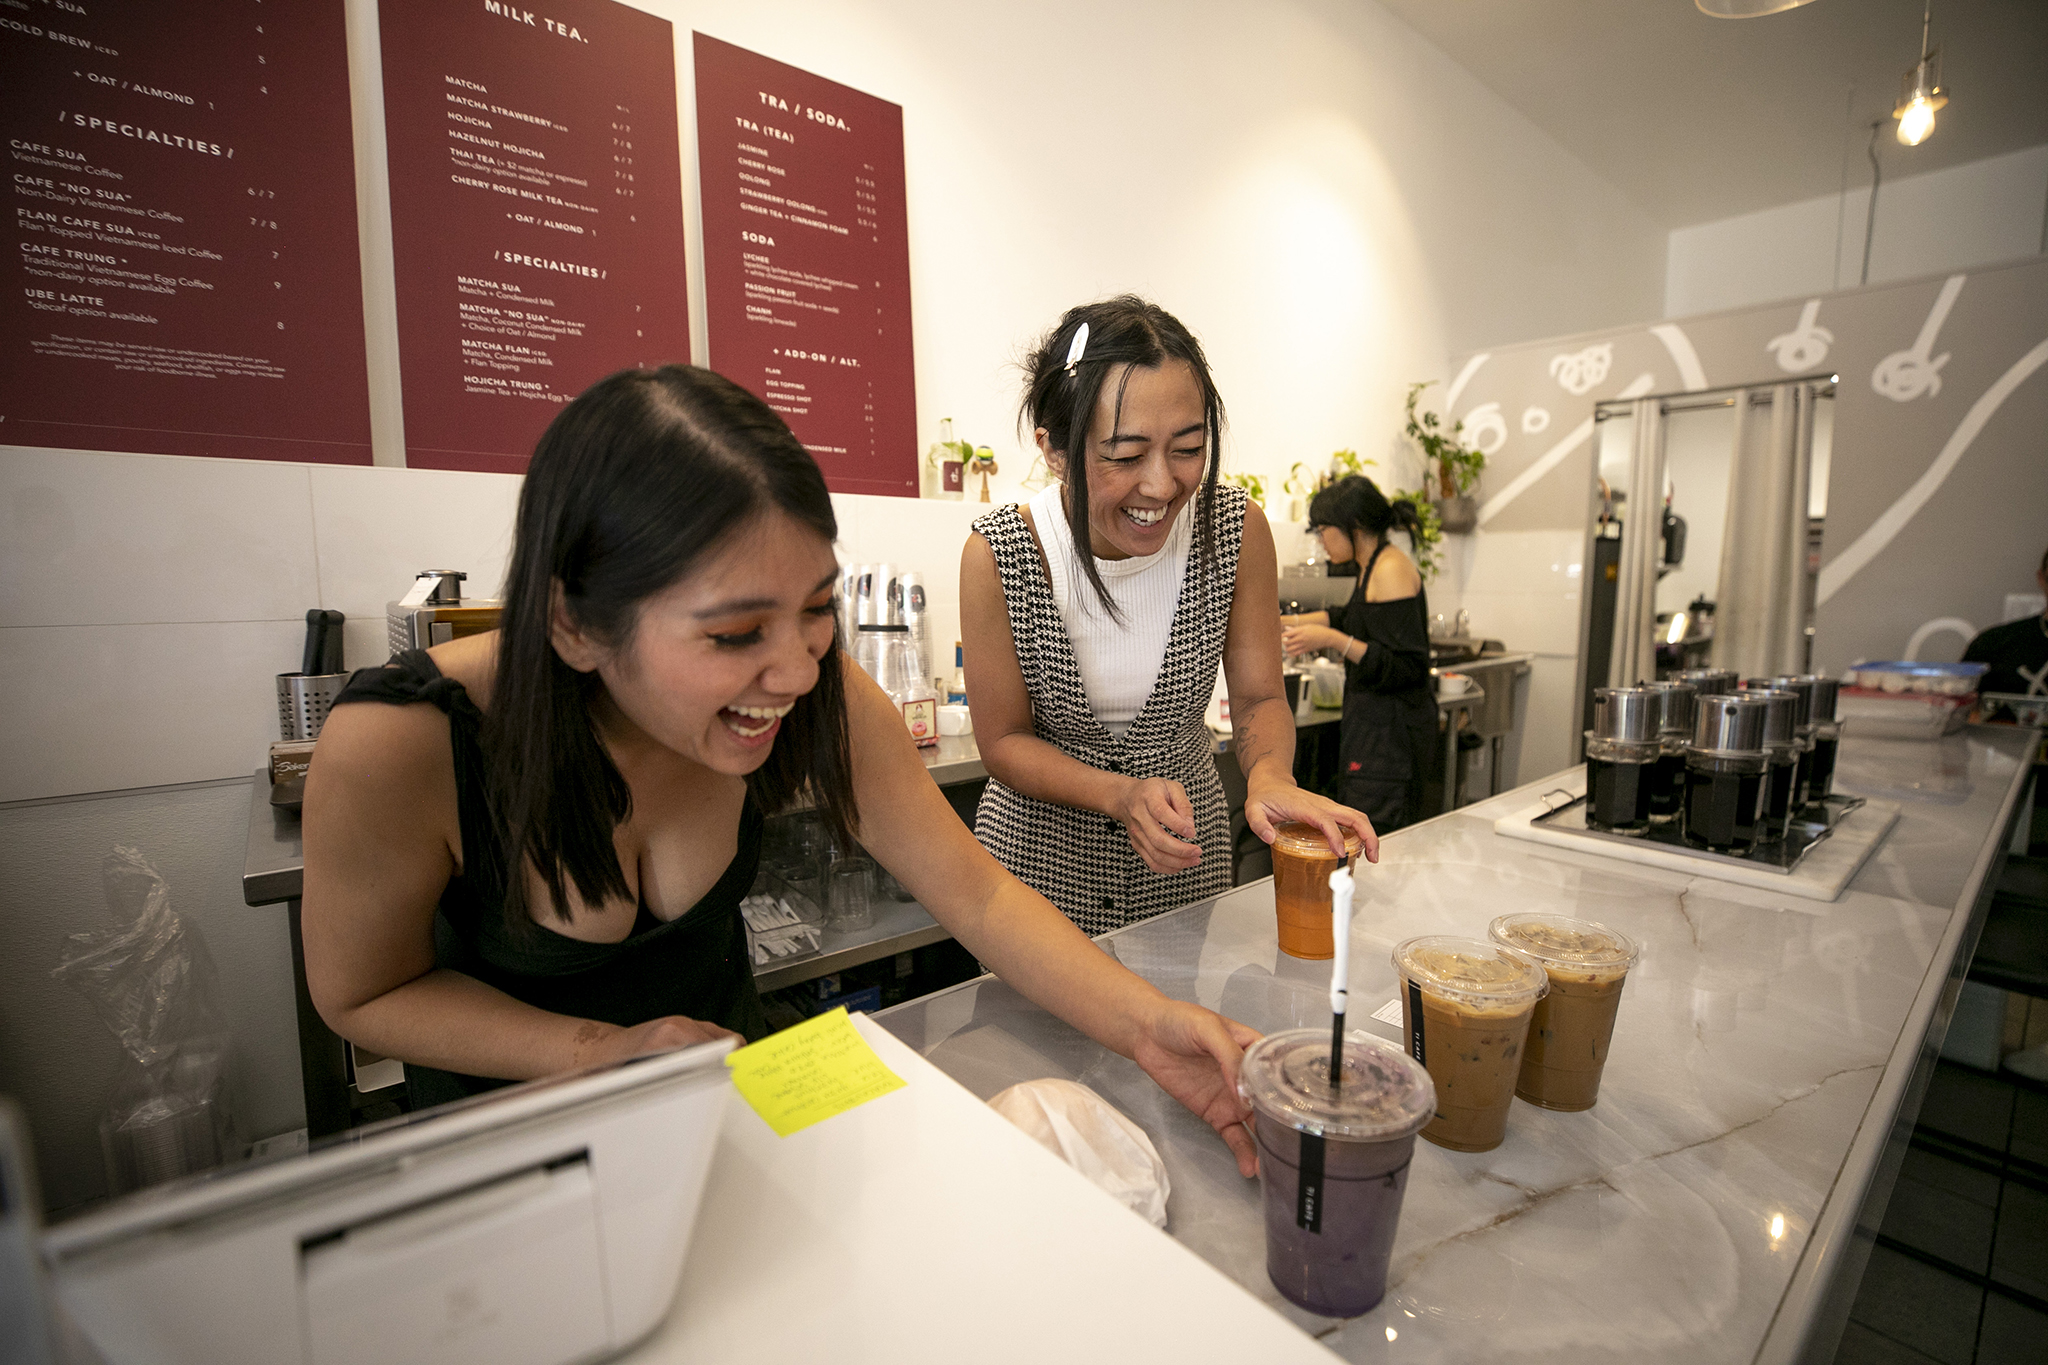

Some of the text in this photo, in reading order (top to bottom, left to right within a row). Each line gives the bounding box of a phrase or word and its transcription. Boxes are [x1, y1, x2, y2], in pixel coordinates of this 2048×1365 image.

[55, 0, 86, 15] SUA
[485, 0, 535, 26] MILK
[0, 18, 42, 36] COLD
[48, 30, 91, 48] BREW
[87, 73, 116, 86] OAT
[133, 84, 194, 104] ALMOND
[445, 75, 487, 93] MATCHA
[446, 93, 488, 111] MATCHA
[490, 105, 551, 127] STRAWBERRY
[447, 111, 492, 129] HOJICHA
[74, 114, 220, 155] SPECIALTIES
[448, 129, 545, 159] HAZELNUT HOJICHA
[10, 139, 86, 162] CAFE SUA
[449, 147, 473, 159] THAI
[476, 153, 495, 164] TEA
[13, 174, 53, 188] CAFE
[451, 174, 489, 189] CHERRY
[492, 183, 517, 195] ROSE
[520, 189, 543, 201] MILK
[545, 195, 563, 205] TEA
[17, 208, 56, 222] FLAN
[62, 216, 100, 230] CAFE
[105, 223, 134, 235] SUA
[515, 213, 534, 223] OAT
[543, 220, 583, 234] ALMOND
[20, 243, 116, 264] CAFE TRUNG
[503, 252, 598, 278] SPECIALTIES
[457, 275, 521, 292] MATCHA SUA
[25, 288, 103, 306] UBE LATTE
[459, 303, 500, 315] MATCHA
[461, 339, 502, 350] MATCHA
[505, 344, 530, 354] FLAN
[464, 375, 542, 390] HOJICHA TRUNG
[802, 444, 832, 452] ONDENSED
